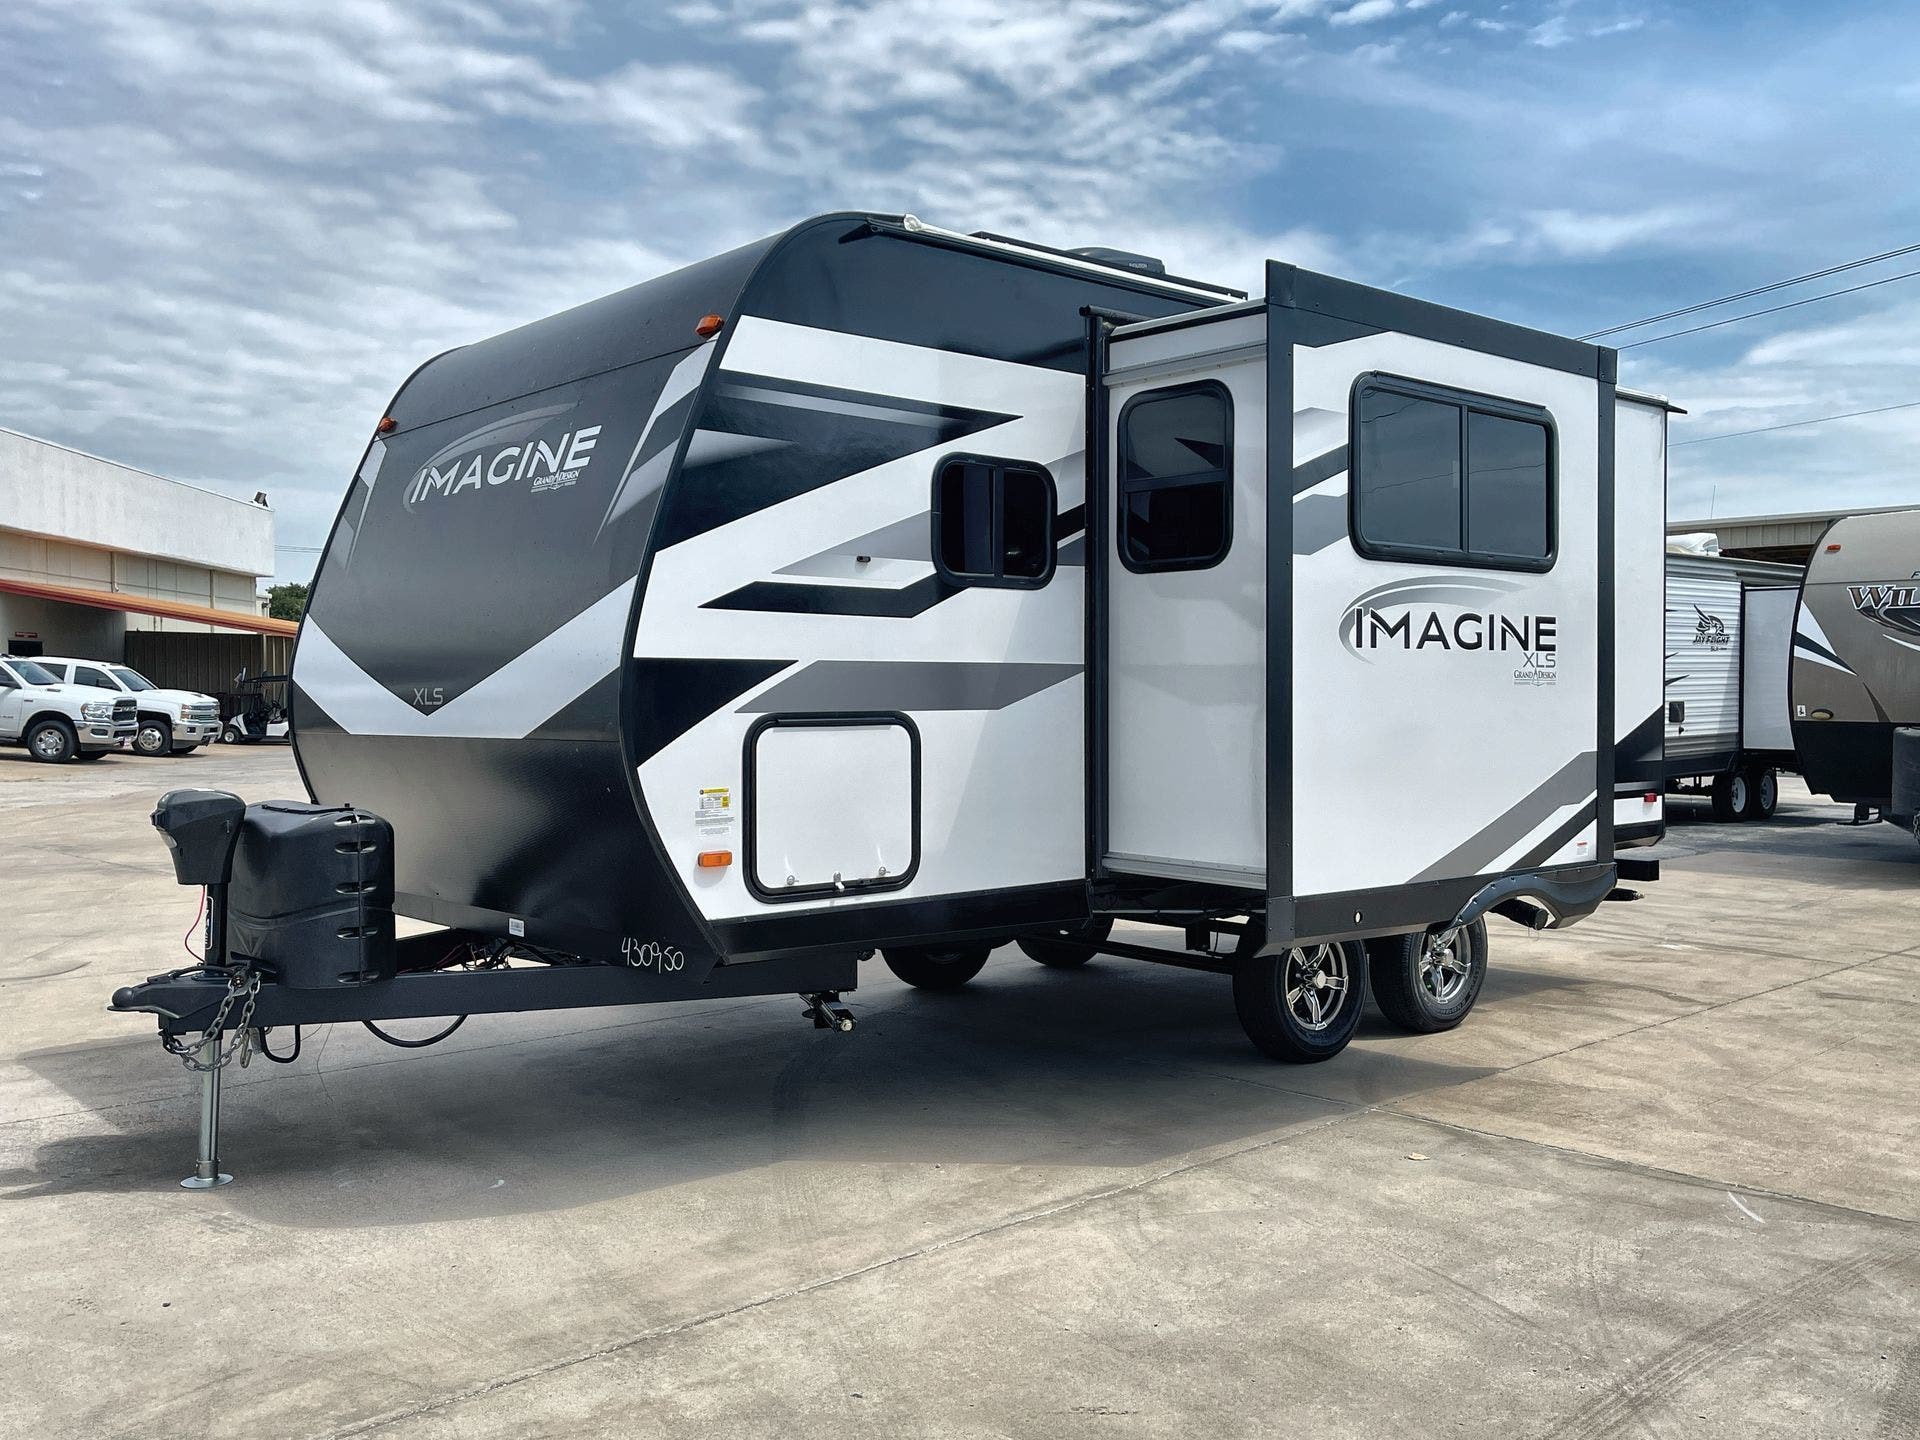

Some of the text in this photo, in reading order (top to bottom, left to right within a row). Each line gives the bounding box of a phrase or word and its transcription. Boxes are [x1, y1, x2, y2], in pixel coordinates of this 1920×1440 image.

[410, 425, 602, 504] IMAGINE
[1355, 608, 1557, 652] IMAGINE
[1513, 669, 1556, 679] GRAND DESIGN
[1522, 652, 1556, 668] XLS
[413, 687, 444, 706] XLS
[621, 937, 685, 974] 430950
